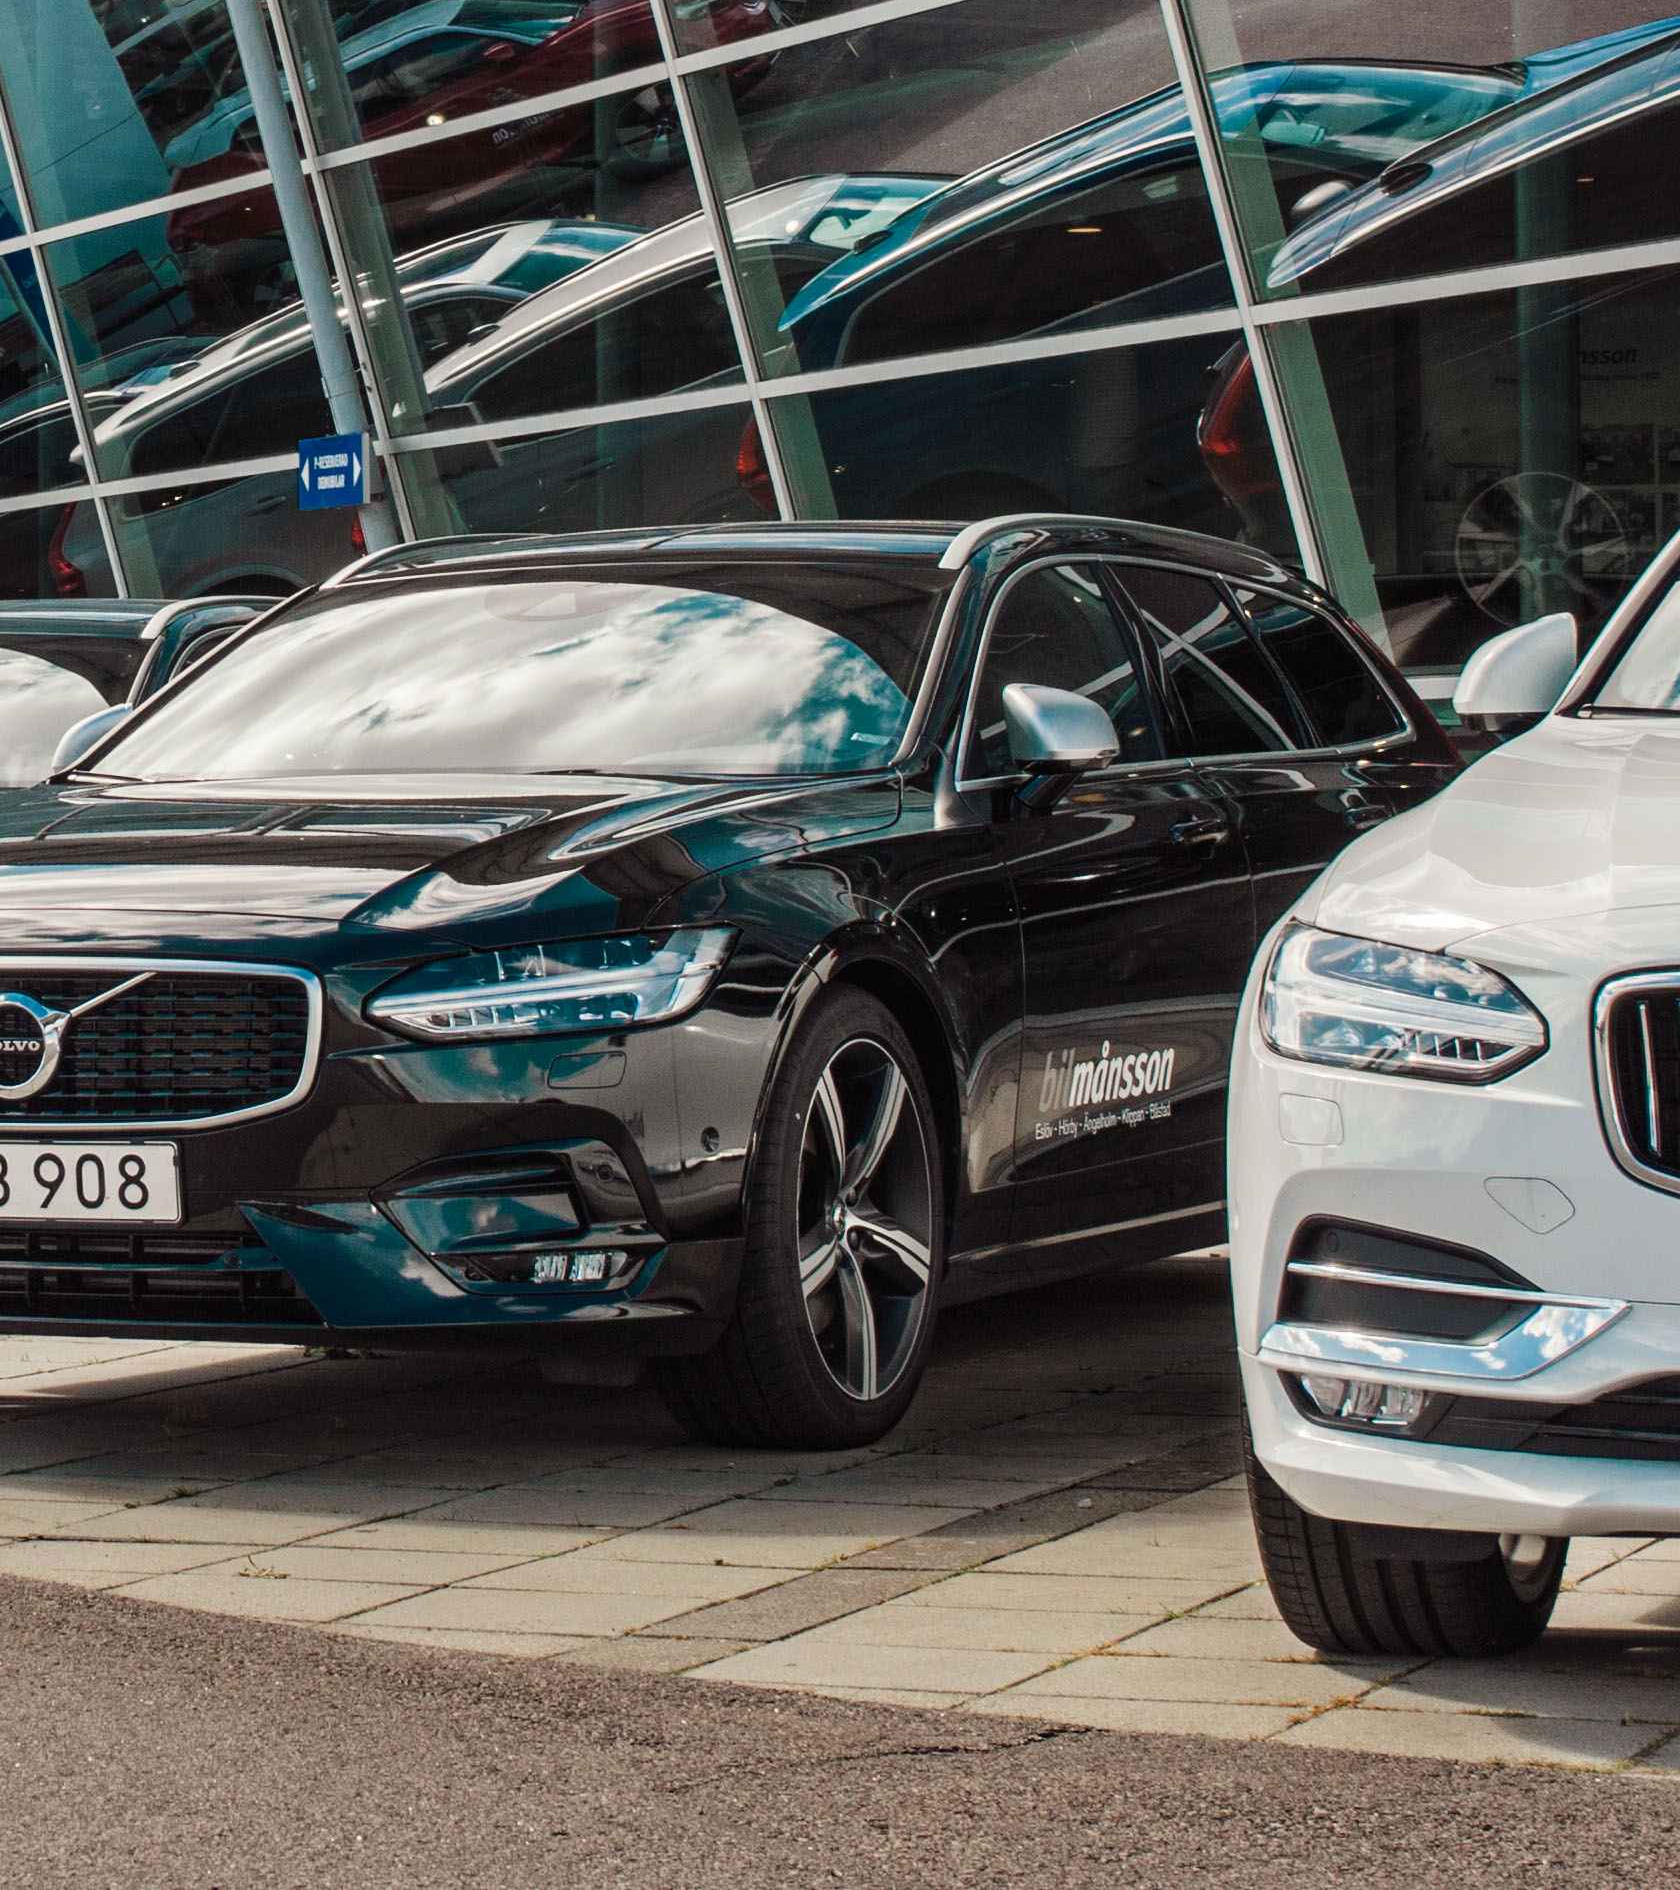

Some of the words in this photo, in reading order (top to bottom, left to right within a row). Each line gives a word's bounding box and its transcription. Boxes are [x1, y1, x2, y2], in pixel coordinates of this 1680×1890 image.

[1038, 1040, 1175, 1113] bilmånsson
[1035, 1123, 1053, 1140] Eslöv
[33, 1152, 149, 1210] 908
